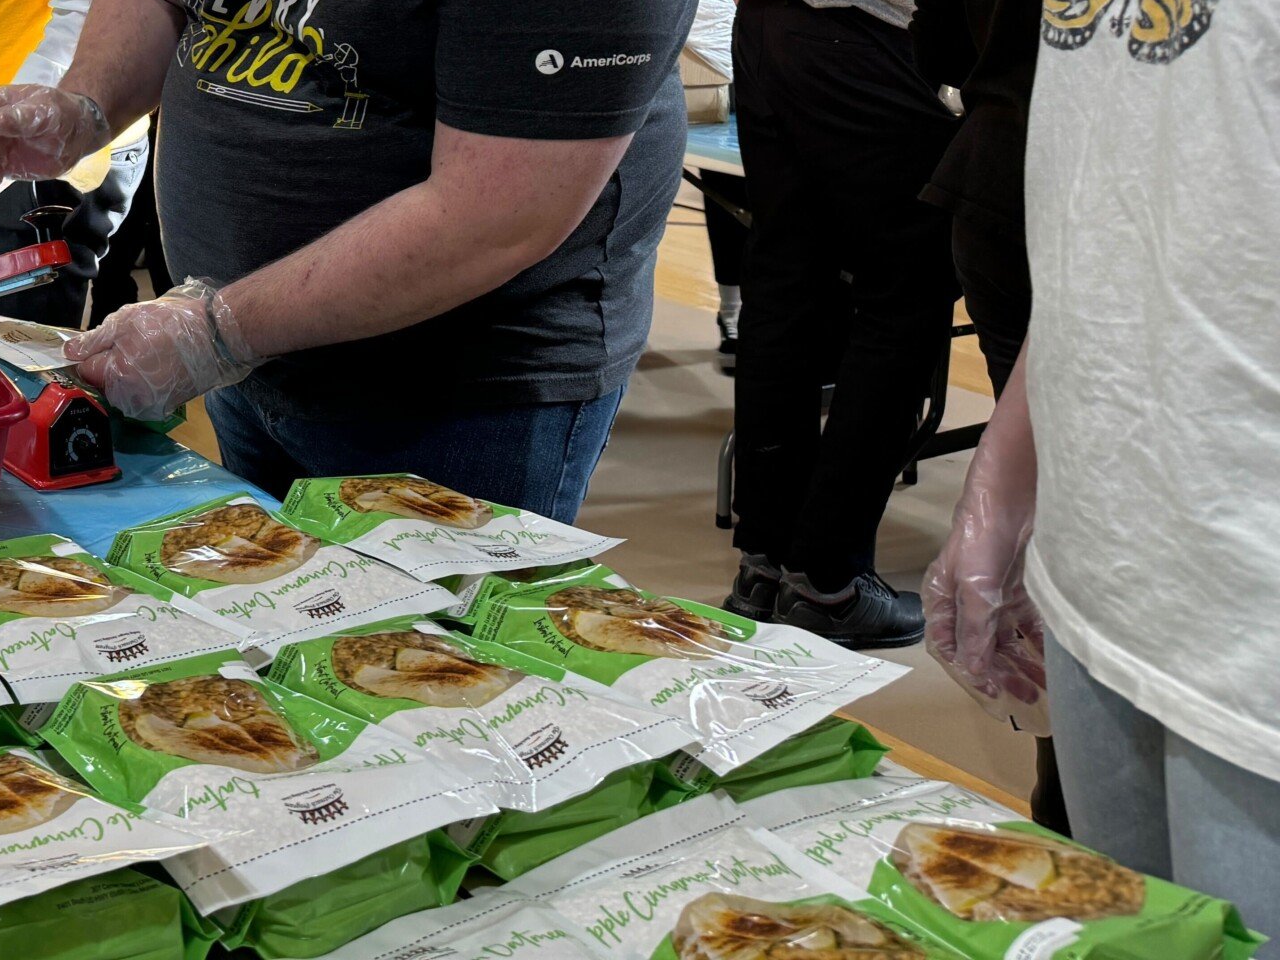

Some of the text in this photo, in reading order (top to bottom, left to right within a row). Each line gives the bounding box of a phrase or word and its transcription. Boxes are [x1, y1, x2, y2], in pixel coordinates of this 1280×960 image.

[570, 54, 652, 68] AmeriCorps
[383, 528, 456, 552] Oatmeal
[213, 554, 375, 620] pple Cinnamon Oatme
[117, 637, 137, 648] Outreach
[413, 718, 490, 748] Oatmea
[176, 776, 260, 820] Oatmea
[283, 802, 310, 810] Program
[310, 792, 334, 807] Outreach
[586, 908, 630, 948] pple
[716, 847, 800, 888] Oatmeal
[482, 929, 567, 958] Oatmea
